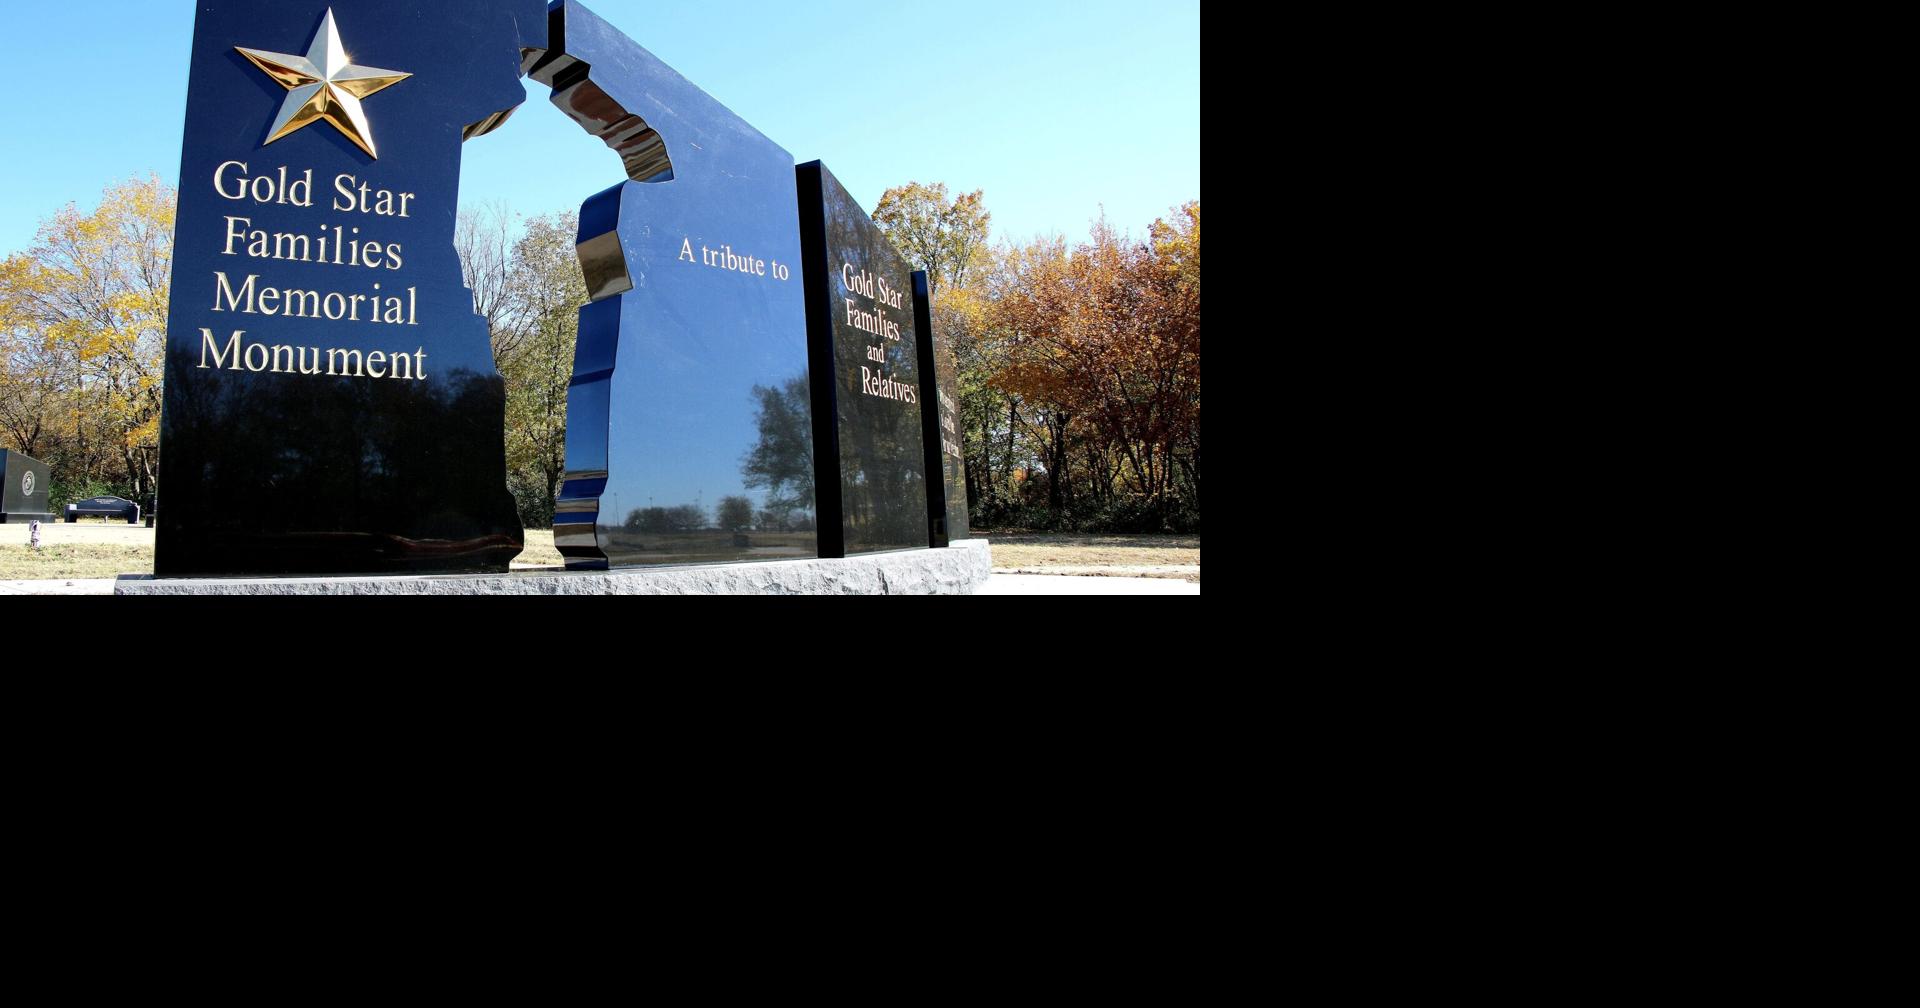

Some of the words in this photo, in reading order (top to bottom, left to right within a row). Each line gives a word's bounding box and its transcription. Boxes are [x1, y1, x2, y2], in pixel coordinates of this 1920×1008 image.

[213, 160, 313, 207] Gold
[333, 173, 415, 218] Star
[221, 215, 402, 270] Families
[679, 237, 696, 263] A
[702, 245, 765, 276] tribute
[771, 259, 789, 281] to
[210, 271, 419, 325] Memorial
[842, 263, 874, 299] Gold
[878, 277, 902, 310] Star
[845, 298, 900, 341] Families
[196, 327, 428, 380] Monument
[867, 342, 885, 363] and
[860, 366, 916, 404] Relatives
